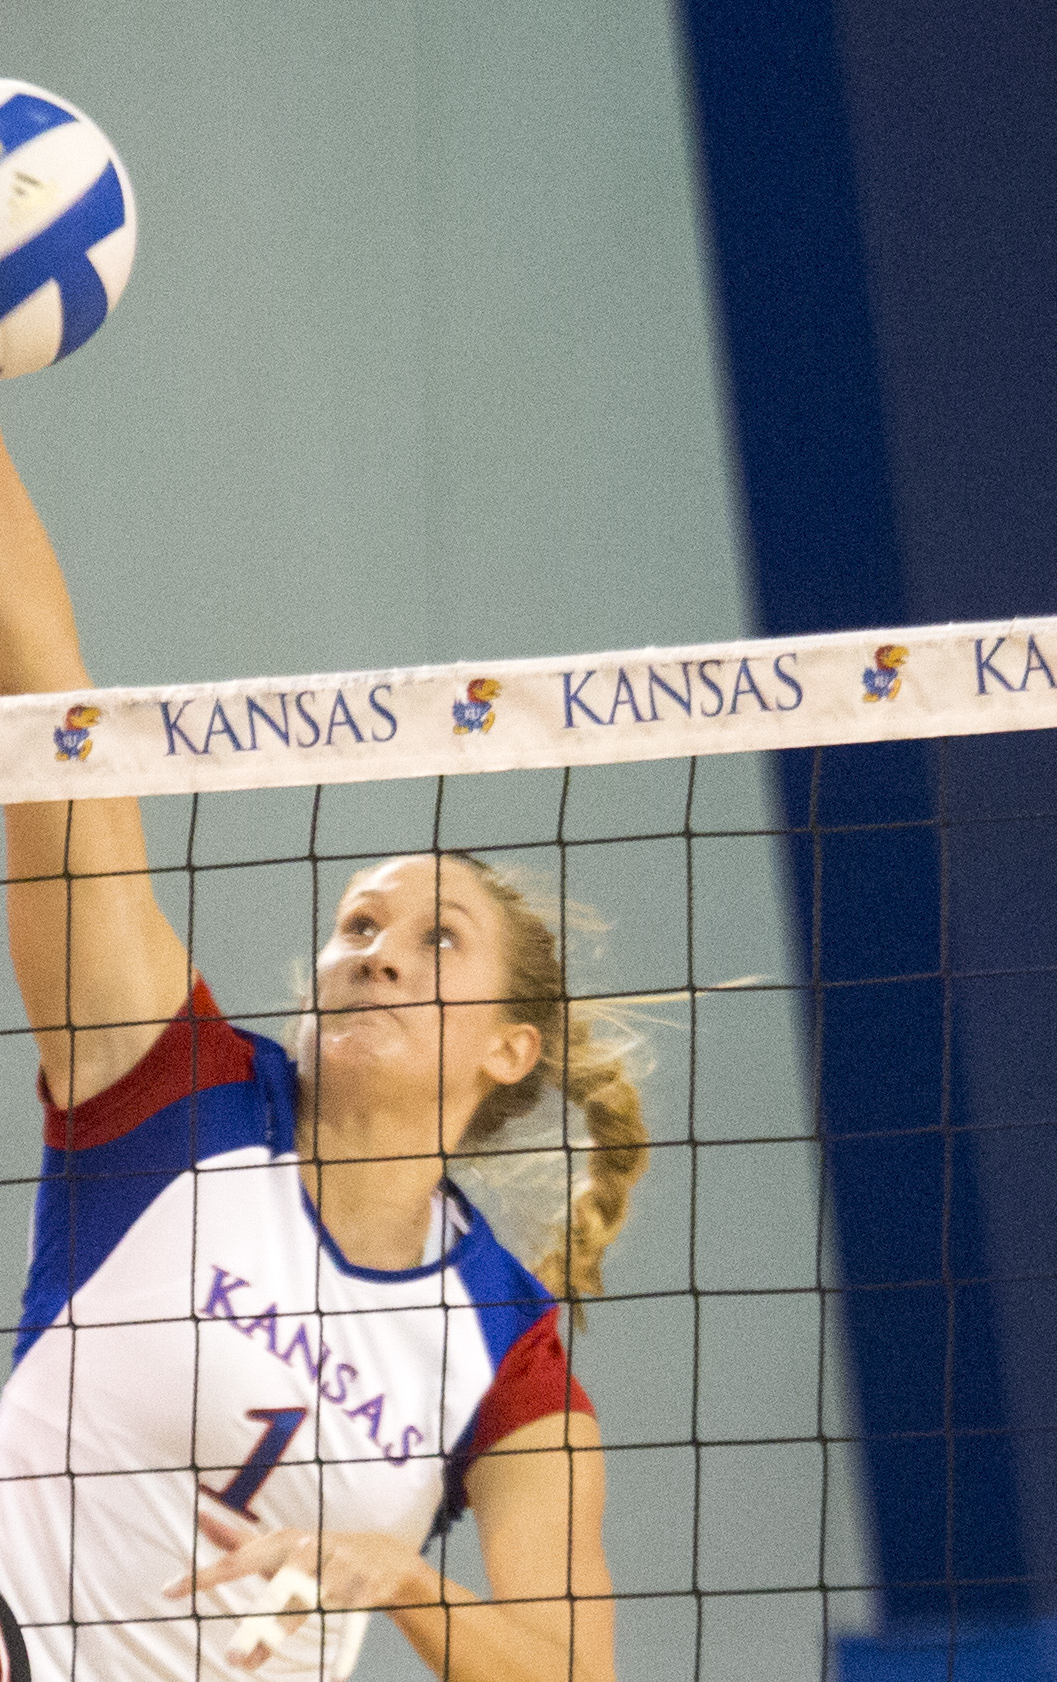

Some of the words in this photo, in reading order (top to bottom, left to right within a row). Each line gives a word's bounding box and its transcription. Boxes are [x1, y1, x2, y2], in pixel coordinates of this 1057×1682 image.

[160, 684, 399, 756] KANSAS
[559, 653, 805, 728] KANSAS
[974, 634, 1057, 696] KA
[201, 1265, 424, 1467] KANSAS
[199, 1407, 308, 1522] 1
